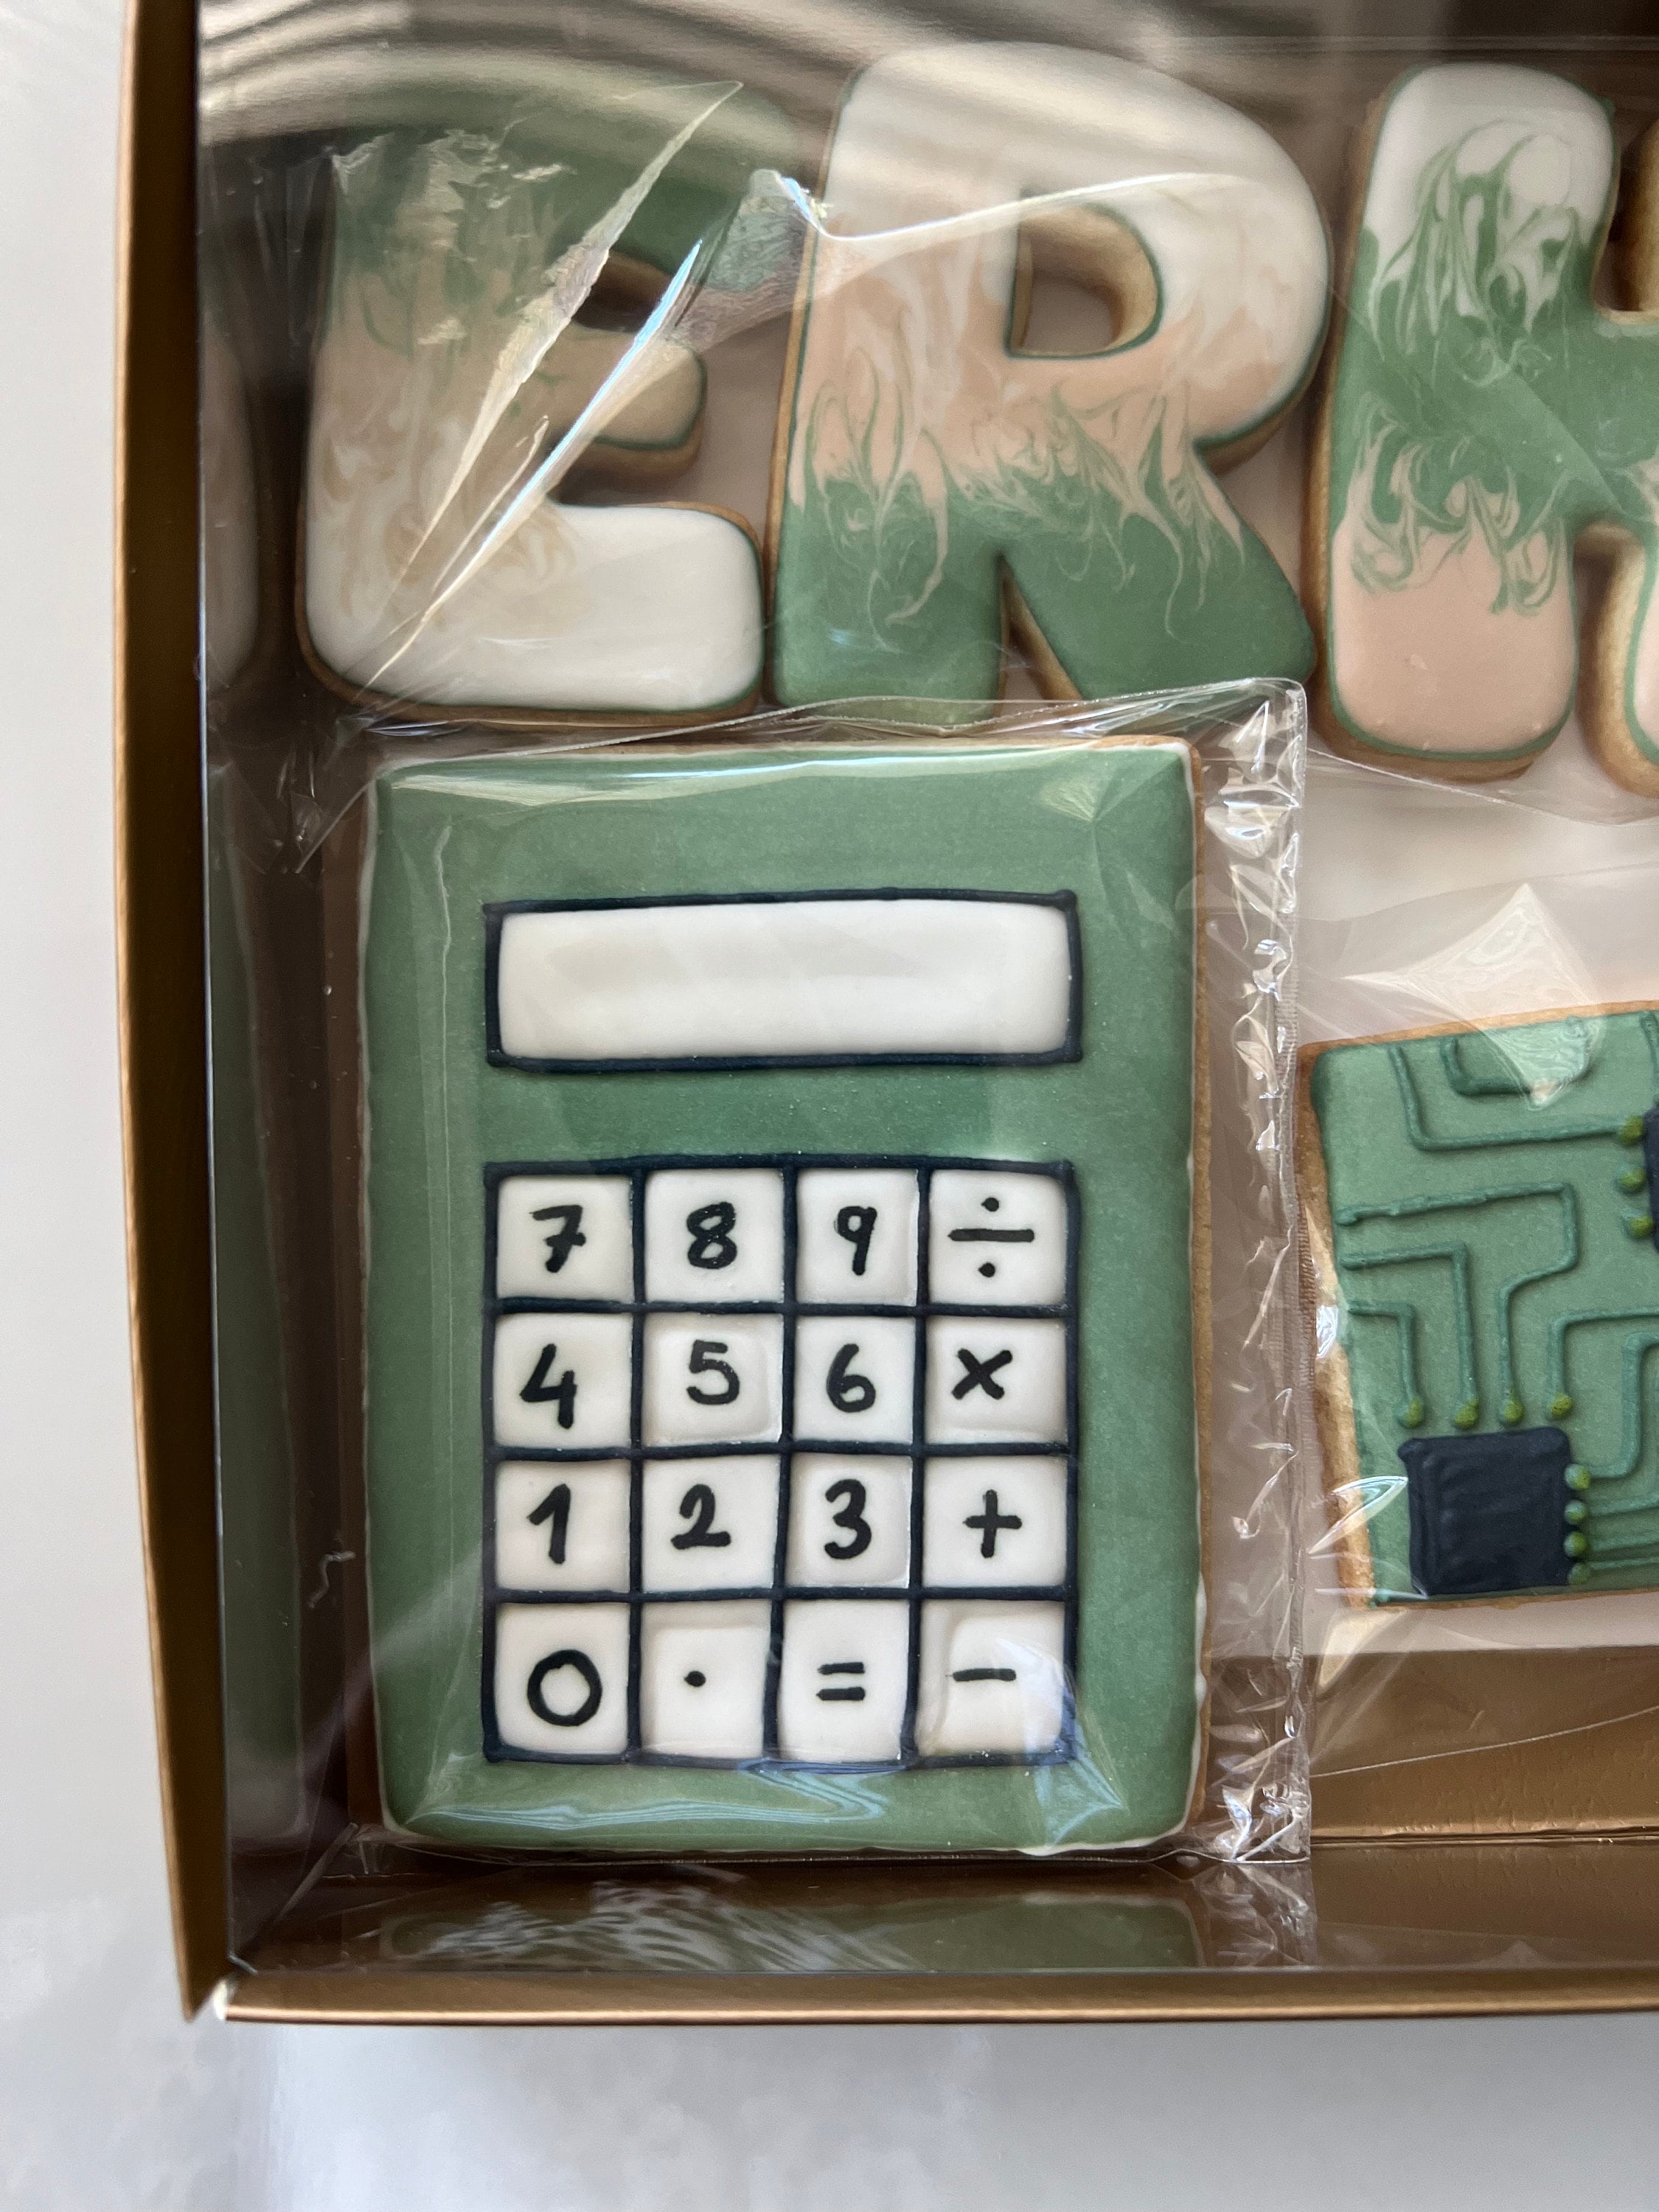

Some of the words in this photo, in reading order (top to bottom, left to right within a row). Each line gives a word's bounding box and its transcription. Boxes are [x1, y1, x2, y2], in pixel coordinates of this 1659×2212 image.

[532, 1203, 587, 1274] 7
[685, 1200, 738, 1270] 8
[836, 1205, 878, 1277] 9
[518, 1343, 578, 1430] 4
[686, 1339, 741, 1406] 5
[825, 1343, 877, 1414] 6
[526, 1483, 572, 1565] 1
[669, 1483, 732, 1551] 2
[823, 1478, 873, 1561] 3
[962, 1489, 1023, 1559] +
[526, 1648, 604, 1728] 0
[815, 1661, 866, 1703] =
